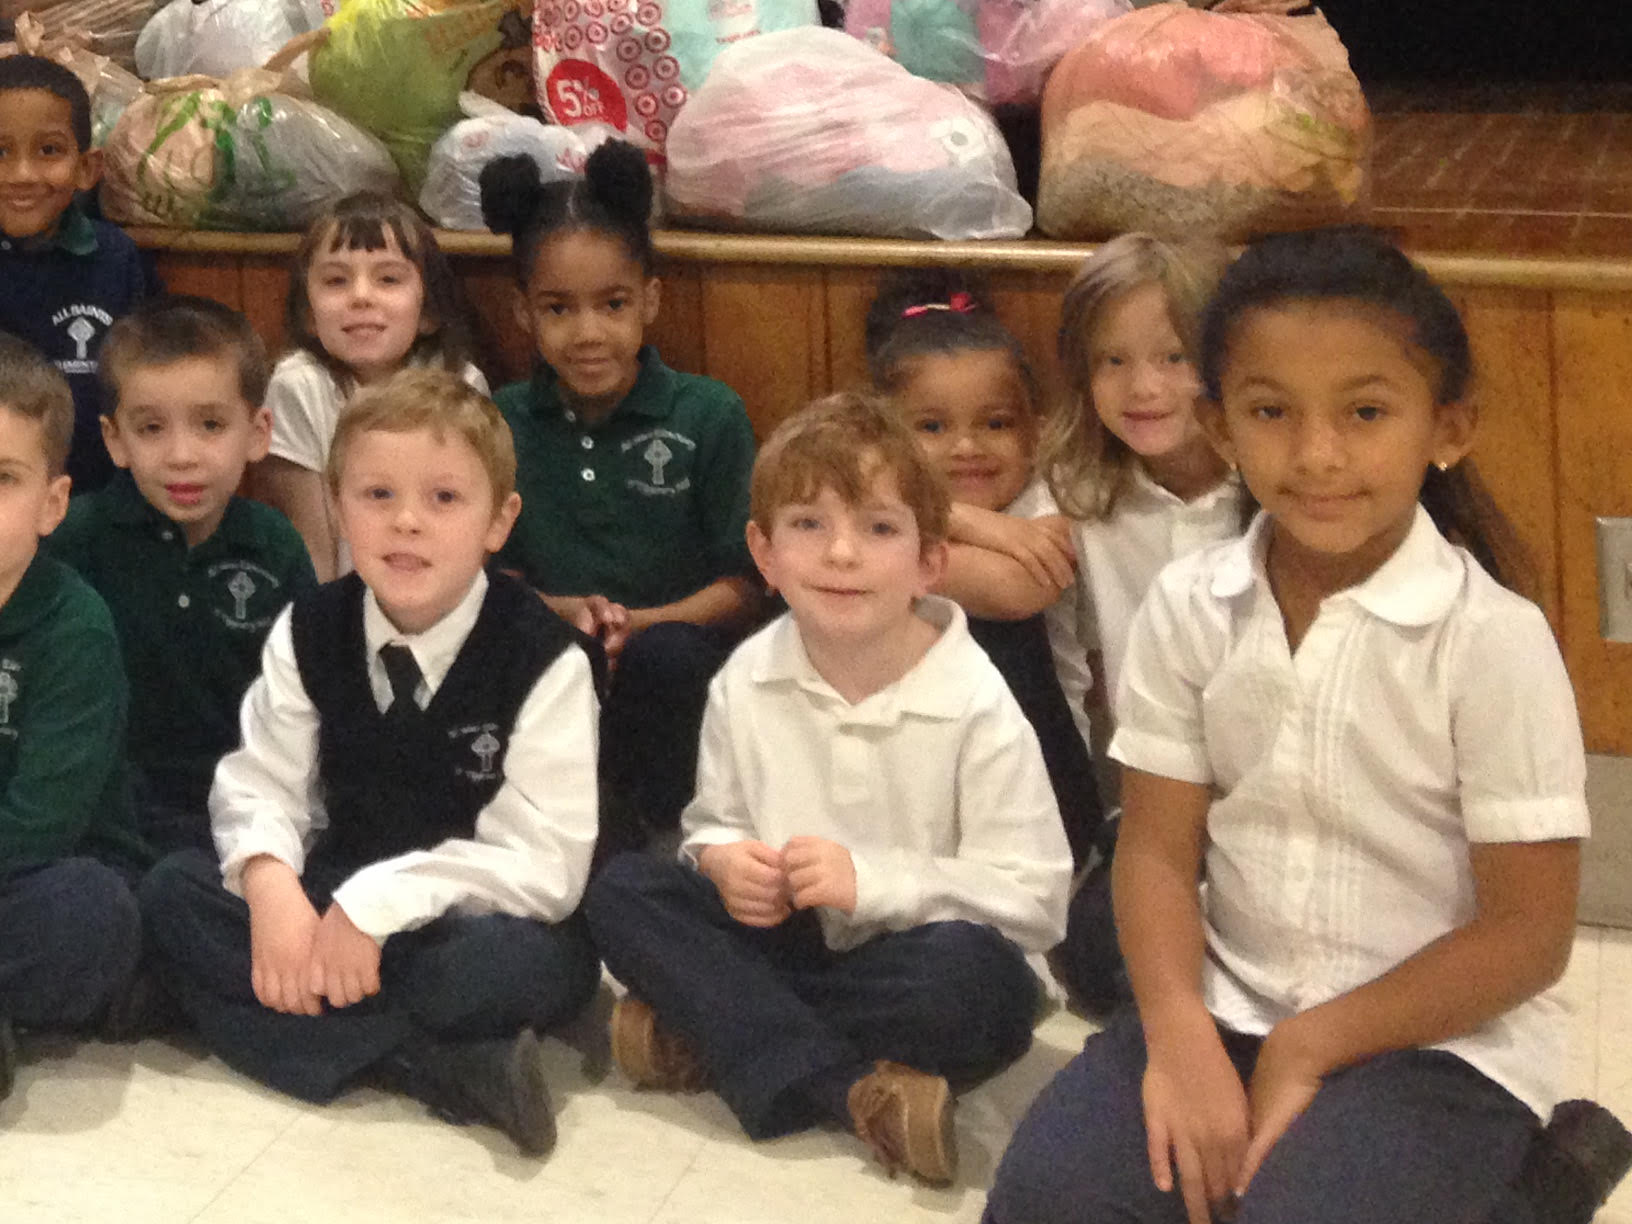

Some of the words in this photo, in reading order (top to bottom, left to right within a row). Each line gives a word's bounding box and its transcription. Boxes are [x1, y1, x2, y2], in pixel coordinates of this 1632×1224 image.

[556, 79, 600, 117] 5%
[51, 307, 71, 327] ALL
[70, 302, 114, 327] SAINTS
